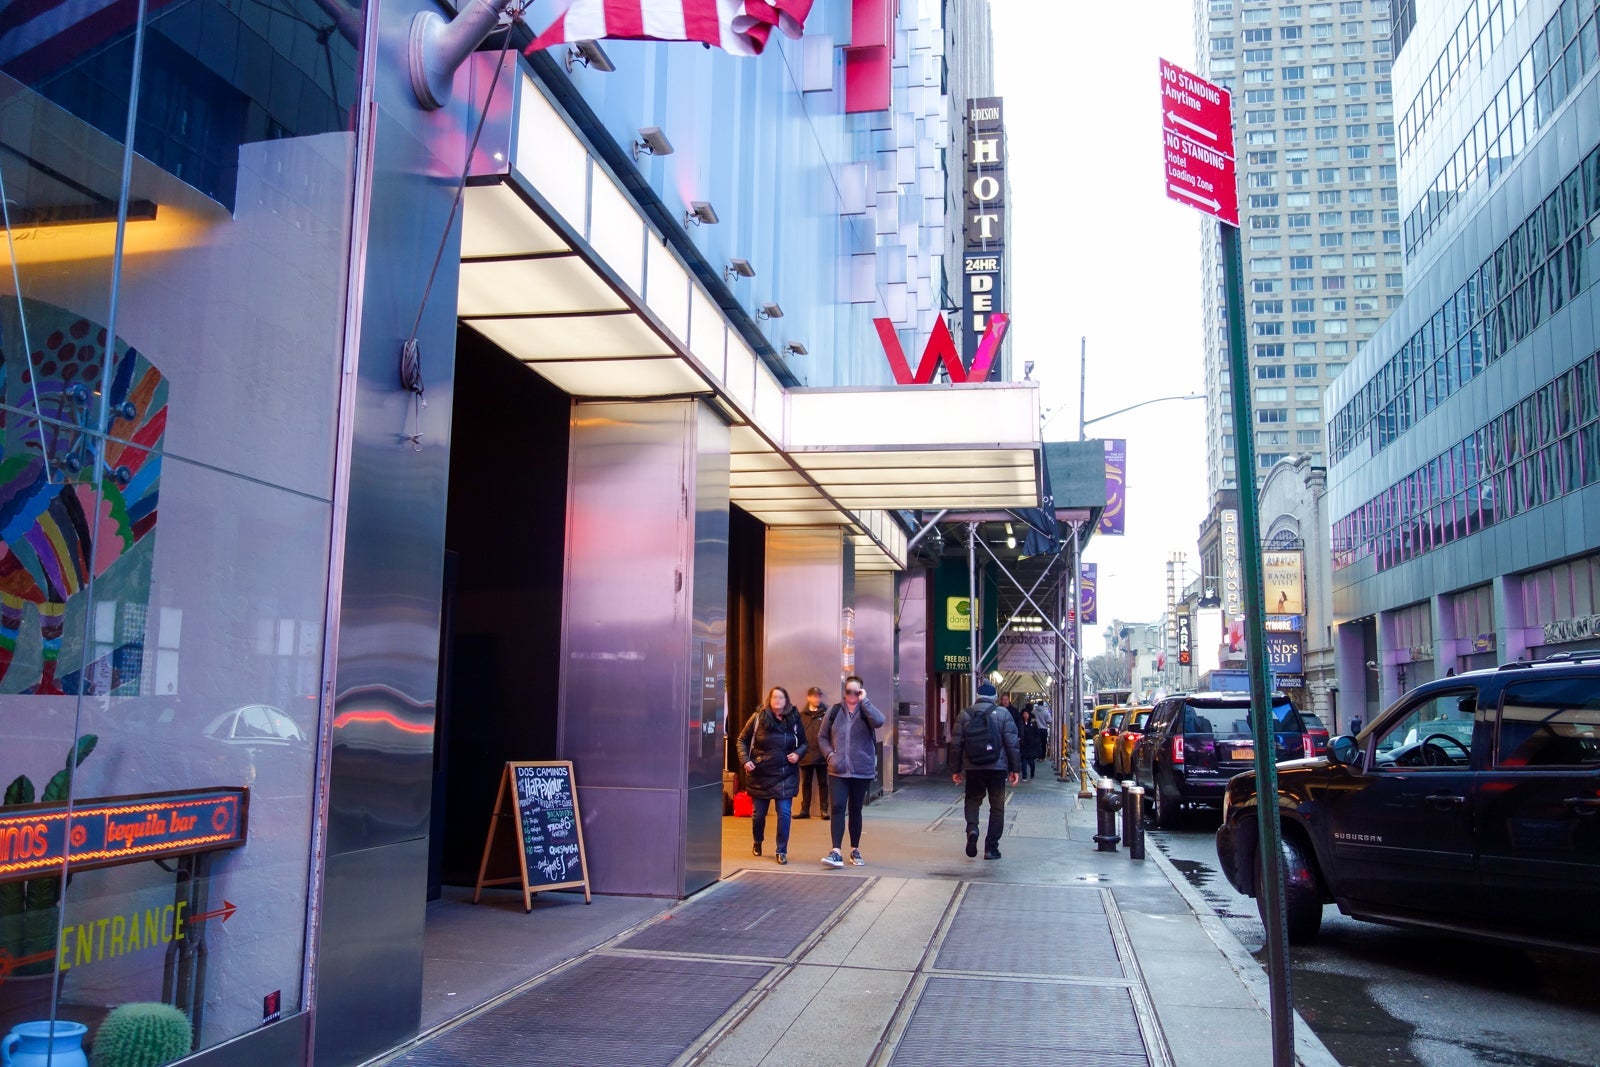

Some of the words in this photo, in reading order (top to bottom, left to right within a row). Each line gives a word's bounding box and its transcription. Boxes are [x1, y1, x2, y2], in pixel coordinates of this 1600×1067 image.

[1163, 66, 1177, 83] NO
[1178, 73, 1220, 105] STANDING
[1165, 83, 1201, 111] Anytime
[971, 107, 999, 121] EDISON
[1166, 133, 1180, 150] NO
[1182, 141, 1224, 170] STANDING
[1167, 150, 1187, 168] Hotel
[1168, 164, 1196, 187] Loading
[1196, 175, 1214, 192] Zone
[872, 312, 1010, 385] W
[1225, 513, 1238, 615] BARRYMORE
[1180, 618, 1189, 651] PARK
[707, 653, 714, 670] W
[944, 655, 957, 663] FREE
[518, 767, 535, 776] DOS
[536, 767, 568, 776] CAMINOS
[107, 813, 167, 848] tequila
[170, 811, 198, 833] bar
[1335, 832, 1383, 842] SUBURBAN
[60, 901, 187, 971] ENTRANCE
